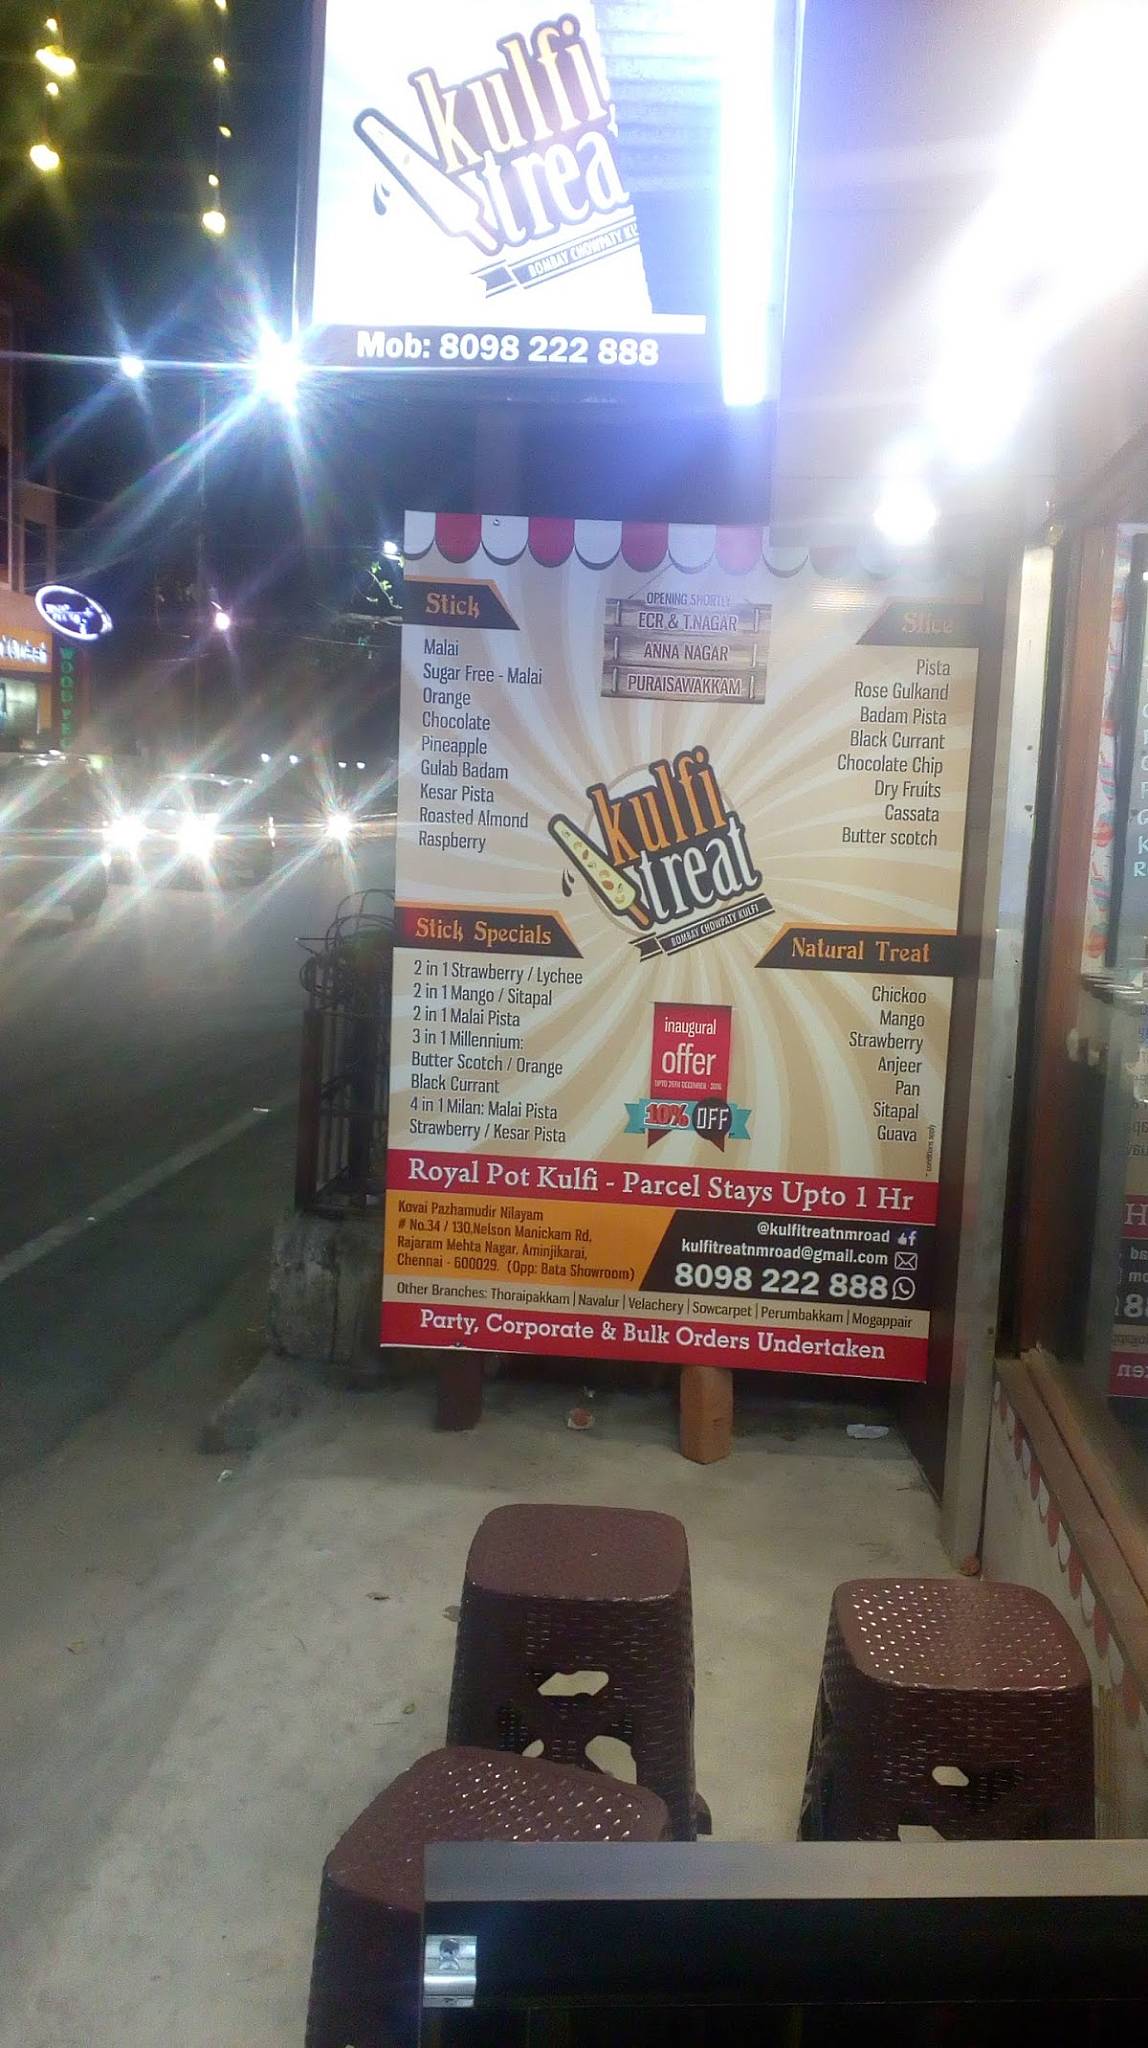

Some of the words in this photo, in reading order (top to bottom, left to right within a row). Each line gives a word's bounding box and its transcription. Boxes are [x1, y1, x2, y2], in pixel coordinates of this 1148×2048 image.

[411, 14, 608, 175] kulfi
[458, 106, 632, 248] trea
[356, 331, 430, 359] Mob:
[439, 333, 519, 361] 8098
[528, 336, 588, 364] 222
[597, 338, 659, 367] 888
[424, 592, 481, 620] Stick
[646, 592, 687, 605] OPENING
[638, 612, 663, 629] ECR
[668, 614, 679, 629] &
[683, 614, 738, 632] T.NAGAR
[423, 638, 460, 656] Malai
[643, 643, 680, 660] ANNA
[684, 644, 730, 662] NAGAR
[422, 663, 461, 684] Sugar
[466, 666, 495, 683] Free
[507, 668, 543, 685] Malai
[916, 658, 951, 676] Pista
[627, 674, 742, 696] PURAISAWAKKAM
[854, 681, 888, 699] Rose
[892, 682, 949, 700] Gulkand
[422, 687, 471, 710] Orange
[422, 711, 491, 731] Chocolate
[860, 706, 908, 724] Badam
[912, 708, 947, 725] Pista
[421, 736, 488, 757] Pineapple
[850, 730, 887, 748] Black
[892, 732, 945, 750] Currant
[421, 760, 458, 778] Gulab
[462, 761, 509, 780] Badam
[837, 754, 908, 773] Chocolate
[912, 757, 943, 777] Chip
[420, 783, 456, 801] Kesar
[461, 785, 495, 803] Pista
[874, 780, 898, 800] Dry
[902, 781, 941, 798] Fruits
[419, 807, 474, 826] Roasted
[477, 809, 529, 829] Almond
[590, 750, 727, 866] kulfi
[884, 805, 939, 822] Cassata
[418, 831, 486, 853] Raspberry
[842, 826, 887, 845] Butter
[890, 829, 938, 847] scotch
[623, 815, 760, 920] treat
[415, 917, 464, 943] Stick
[474, 920, 552, 947] Specials
[671, 927, 701, 947] BOMBAY
[700, 912, 737, 935] CHOWPATY
[737, 903, 760, 919] KULFI
[791, 937, 864, 961] Natural
[875, 940, 932, 963] Treat
[413, 960, 423, 976] 2
[426, 960, 438, 977] in
[443, 962, 449, 977] 1
[451, 962, 524, 984] Strawberry
[527, 966, 534, 982] /
[536, 967, 583, 987] Lychee
[413, 983, 422, 999] 2
[425, 983, 438, 999] in
[442, 984, 448, 1000] 1
[450, 985, 495, 1005] Mango
[498, 988, 504, 1003] /
[507, 988, 553, 1009] Sitapal
[871, 985, 927, 1005] Chickoo
[413, 1005, 421, 1021] 2
[425, 1006, 437, 1022] in
[441, 1007, 447, 1022] 1
[450, 1008, 484, 1025] Malai
[487, 1010, 521, 1027] Pista
[879, 1009, 925, 1030] Mango
[664, 1017, 717, 1038] inaugural
[412, 1028, 421, 1044] 3
[424, 1029, 437, 1045] in
[440, 1030, 446, 1046] 1
[449, 1031, 524, 1050] Millennium:
[848, 1031, 924, 1055] Strawberry
[411, 1051, 454, 1069] Butter
[457, 1053, 503, 1071] Scotch
[506, 1057, 513, 1071] /
[516, 1057, 563, 1078] Orange
[661, 1043, 717, 1076] offer
[877, 1056, 923, 1076] Anjeer
[411, 1074, 446, 1091] Black
[450, 1076, 500, 1094] Currant
[895, 1079, 920, 1097] Pan
[410, 1096, 418, 1111] 4
[421, 1096, 434, 1112] in
[437, 1098, 443, 1113] 1
[447, 1098, 484, 1115] Milan:
[488, 1100, 523, 1118] Malai
[525, 1103, 558, 1120] Pista
[644, 1102, 690, 1128] 10%
[696, 1107, 730, 1131] OFF
[873, 1101, 919, 1122] Sitapal
[409, 1118, 481, 1141] Strawberry
[484, 1123, 490, 1138] /
[493, 1124, 531, 1141] Kesar
[533, 1126, 567, 1143] Pista
[877, 1124, 918, 1142] Guava
[408, 1157, 479, 1188] Royal
[486, 1163, 530, 1187] Pot
[537, 1166, 599, 1191] Kulfi
[622, 1171, 701, 1198] Parcel
[707, 1176, 773, 1208] Stays
[781, 1181, 846, 1211] Upto
[855, 1186, 867, 1208] 1
[878, 1186, 914, 1211] Hr
[398, 1199, 428, 1214] Kovai
[431, 1202, 497, 1218] Pazhamudir
[500, 1206, 544, 1223] Nilayam
[409, 1219, 441, 1233] No.34
[443, 1220, 449, 1233] /
[514, 1225, 572, 1241] Manickam
[756, 1221, 891, 1244] @kulfitreatnmroad
[397, 1236, 443, 1252] Rajaram
[446, 1238, 481, 1253] Mehta
[681, 1238, 889, 1266] kulfitreatnmroad@gmail.com
[396, 1253, 443, 1268] Chennai
[506, 1260, 538, 1277] (Opp:
[541, 1263, 568, 1277] Bata
[570, 1264, 636, 1282] Showroom)
[674, 1262, 753, 1291] 8098
[761, 1268, 819, 1296] 222
[828, 1272, 888, 1300] 888
[396, 1281, 428, 1297] Other
[431, 1284, 488, 1300] Branches:
[490, 1287, 570, 1306] Thoraipakkam
[578, 1293, 620, 1308] Navalur
[628, 1297, 684, 1315] Velachery
[692, 1300, 752, 1318] Sowcarpet
[760, 1306, 844, 1324] Perumbakkam
[851, 1311, 913, 1330] Mogappair
[419, 1308, 479, 1335] Party,
[485, 1313, 594, 1340] Corporate
[600, 1319, 617, 1341] &
[622, 1322, 670, 1345] Bulk
[675, 1326, 750, 1351] Orders
[757, 1331, 886, 1360] Undertaken
